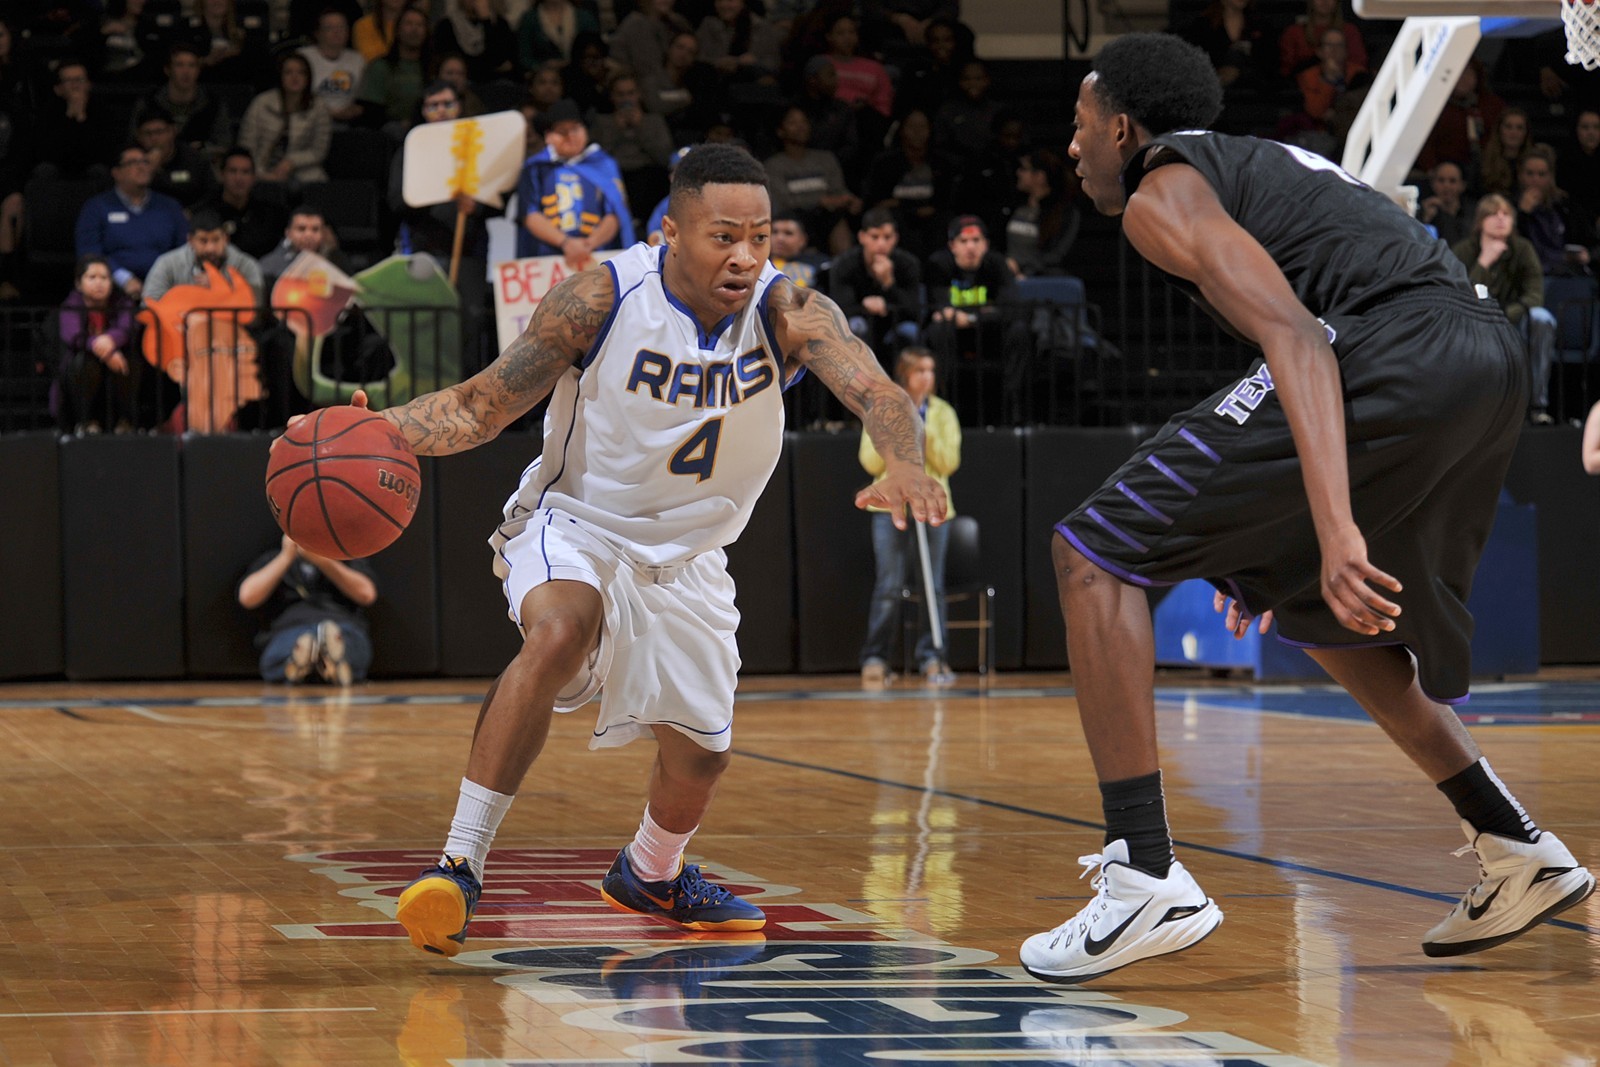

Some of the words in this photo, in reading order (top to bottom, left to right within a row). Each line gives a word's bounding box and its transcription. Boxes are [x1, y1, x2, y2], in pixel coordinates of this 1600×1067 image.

[625, 346, 774, 409] RAMS
[667, 415, 725, 484] 4
[378, 468, 419, 513] ilson
